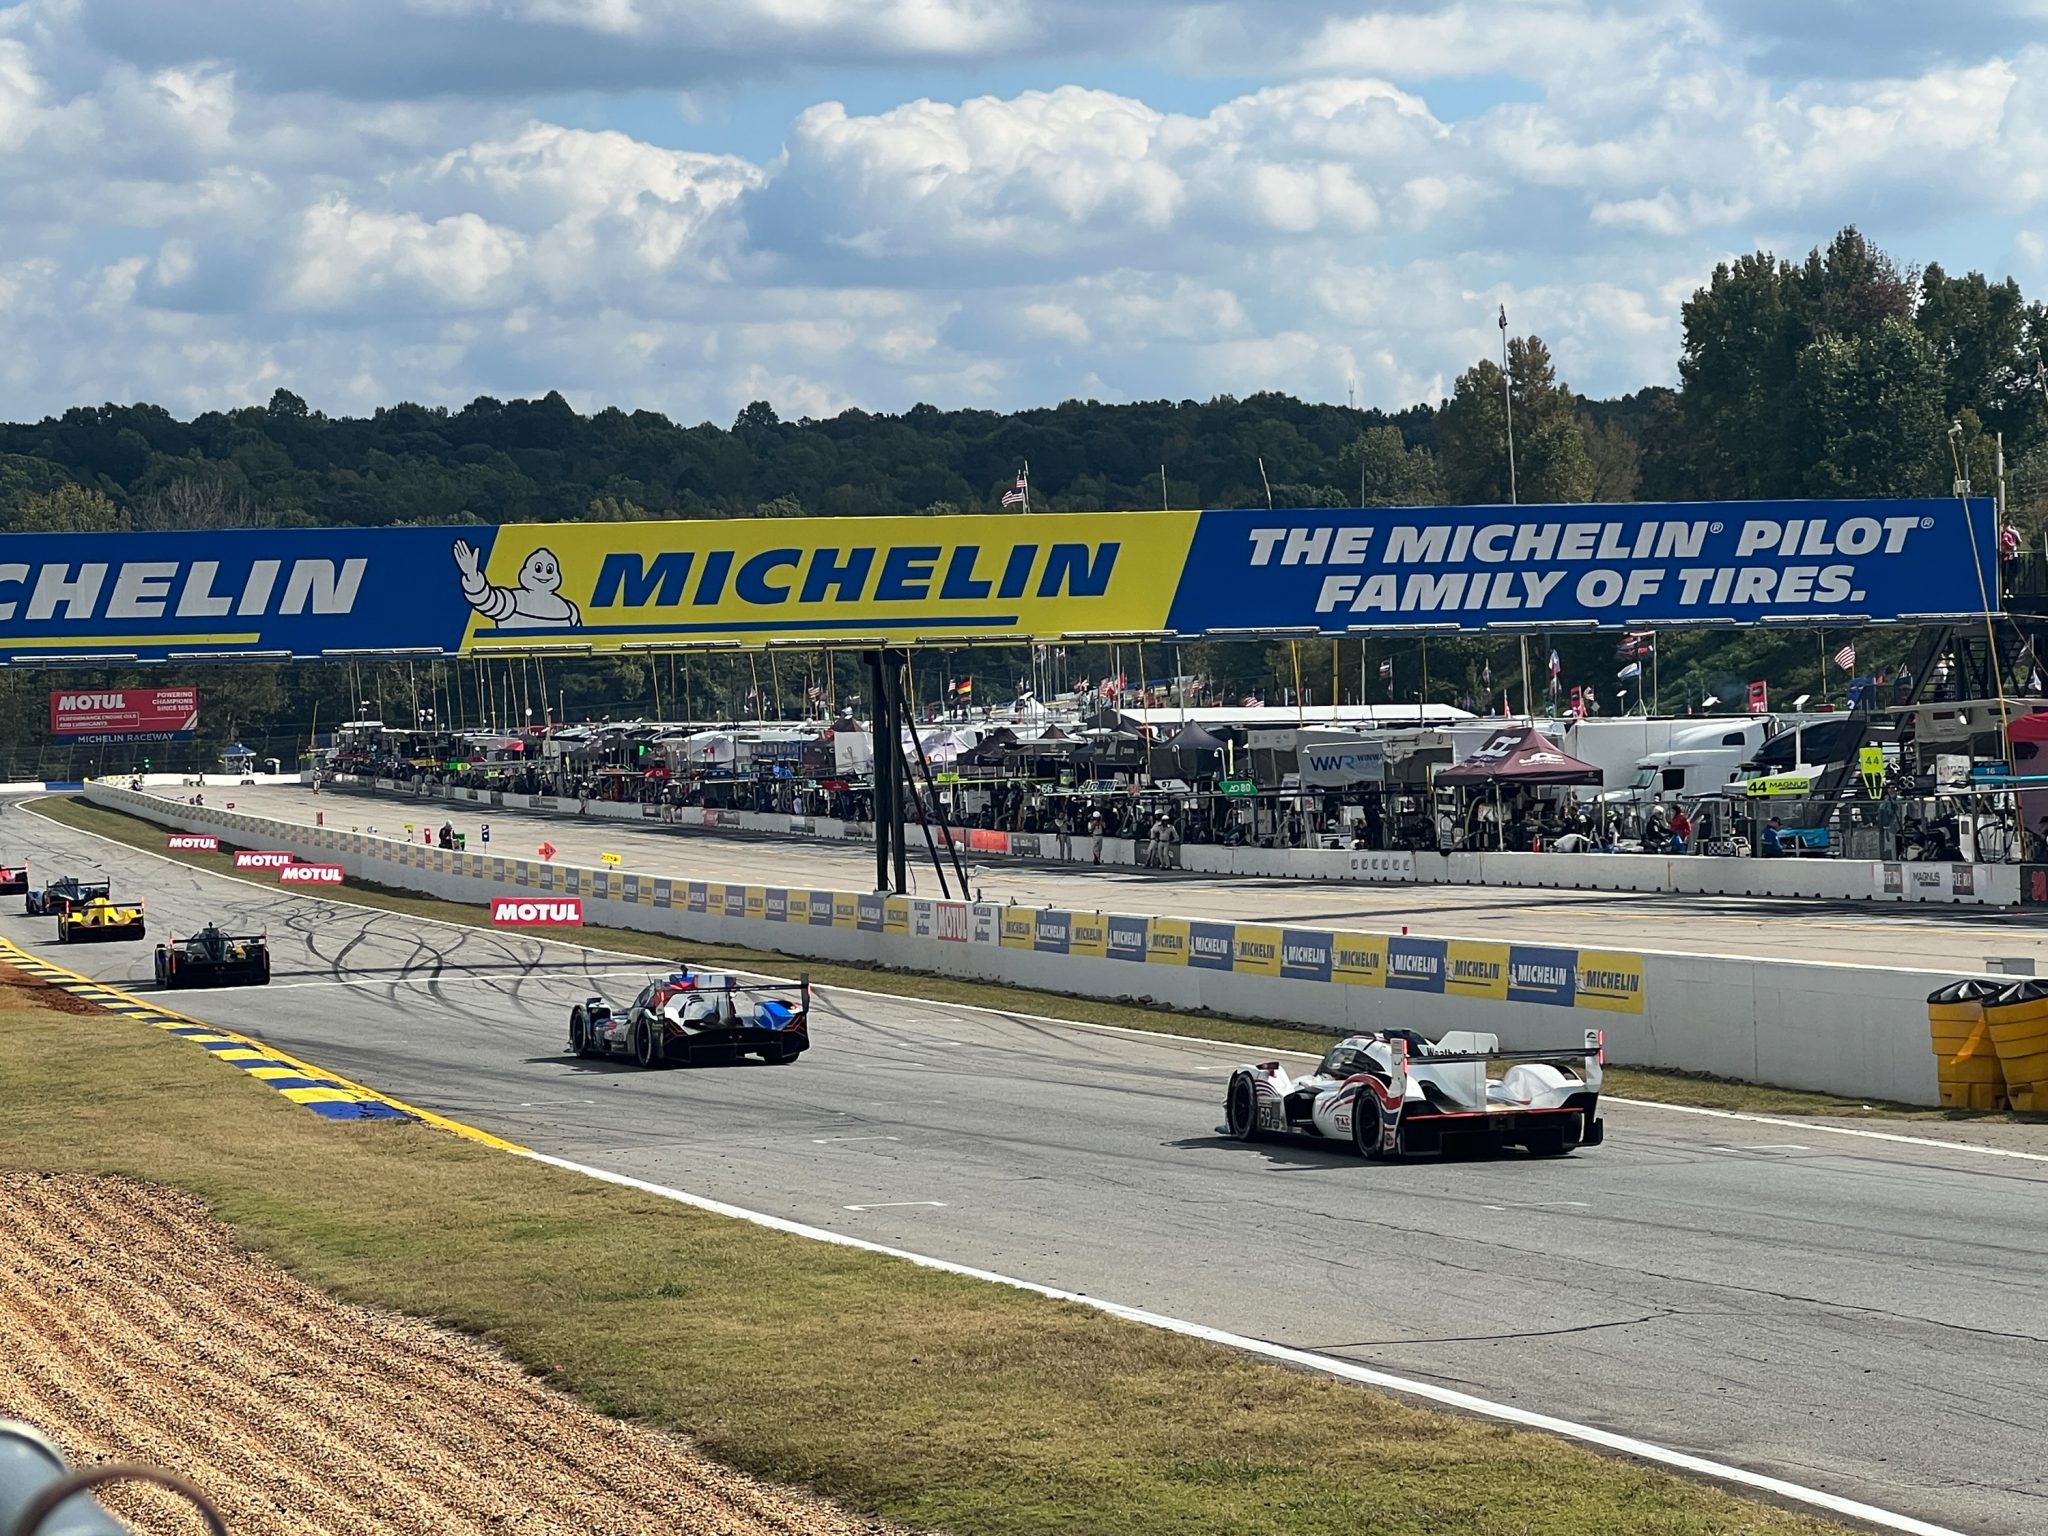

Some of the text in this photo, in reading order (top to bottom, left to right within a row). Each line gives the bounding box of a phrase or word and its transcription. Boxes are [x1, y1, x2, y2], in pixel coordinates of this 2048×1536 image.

[1248, 526, 1374, 565] THE
[589, 542, 1121, 608] MICHELIN
[1314, 564, 1866, 613] FAMILY OF TIRES.
[58, 694, 125, 711] MOTUL
[78, 733, 174, 743] MICHELIN RACEWAY
[1865, 756, 1880, 765] 44
[1985, 767, 1996, 775] 16
[1041, 784, 1053, 794] 66
[1748, 780, 1808, 793] 44 MAGNUS
[1900, 776, 1915, 789] 38
[168, 838, 217, 849] MOTUL
[237, 855, 291, 867] MOTUL
[281, 867, 342, 881] MOTUL
[494, 903, 579, 921] MOTUL
[938, 907, 967, 939] MOTUL
[1039, 924, 1066, 938] MICHELIN
[1112, 930, 1142, 946] MICHELIN
[1152, 934, 1183, 949] MICHELIN
[1195, 937, 1228, 954] MICHELIN
[1241, 942, 1275, 959] MICHELIN
[1288, 946, 1326, 964] MICHELIN
[1340, 950, 1379, 968] MICHELIN
[1394, 955, 1438, 973] MICHELIN
[1455, 960, 1499, 979] MICHELIN
[1518, 964, 1567, 985] MICHELIN
[1586, 970, 1639, 992] MICHELIN
[1260, 1107, 1271, 1127] 59
